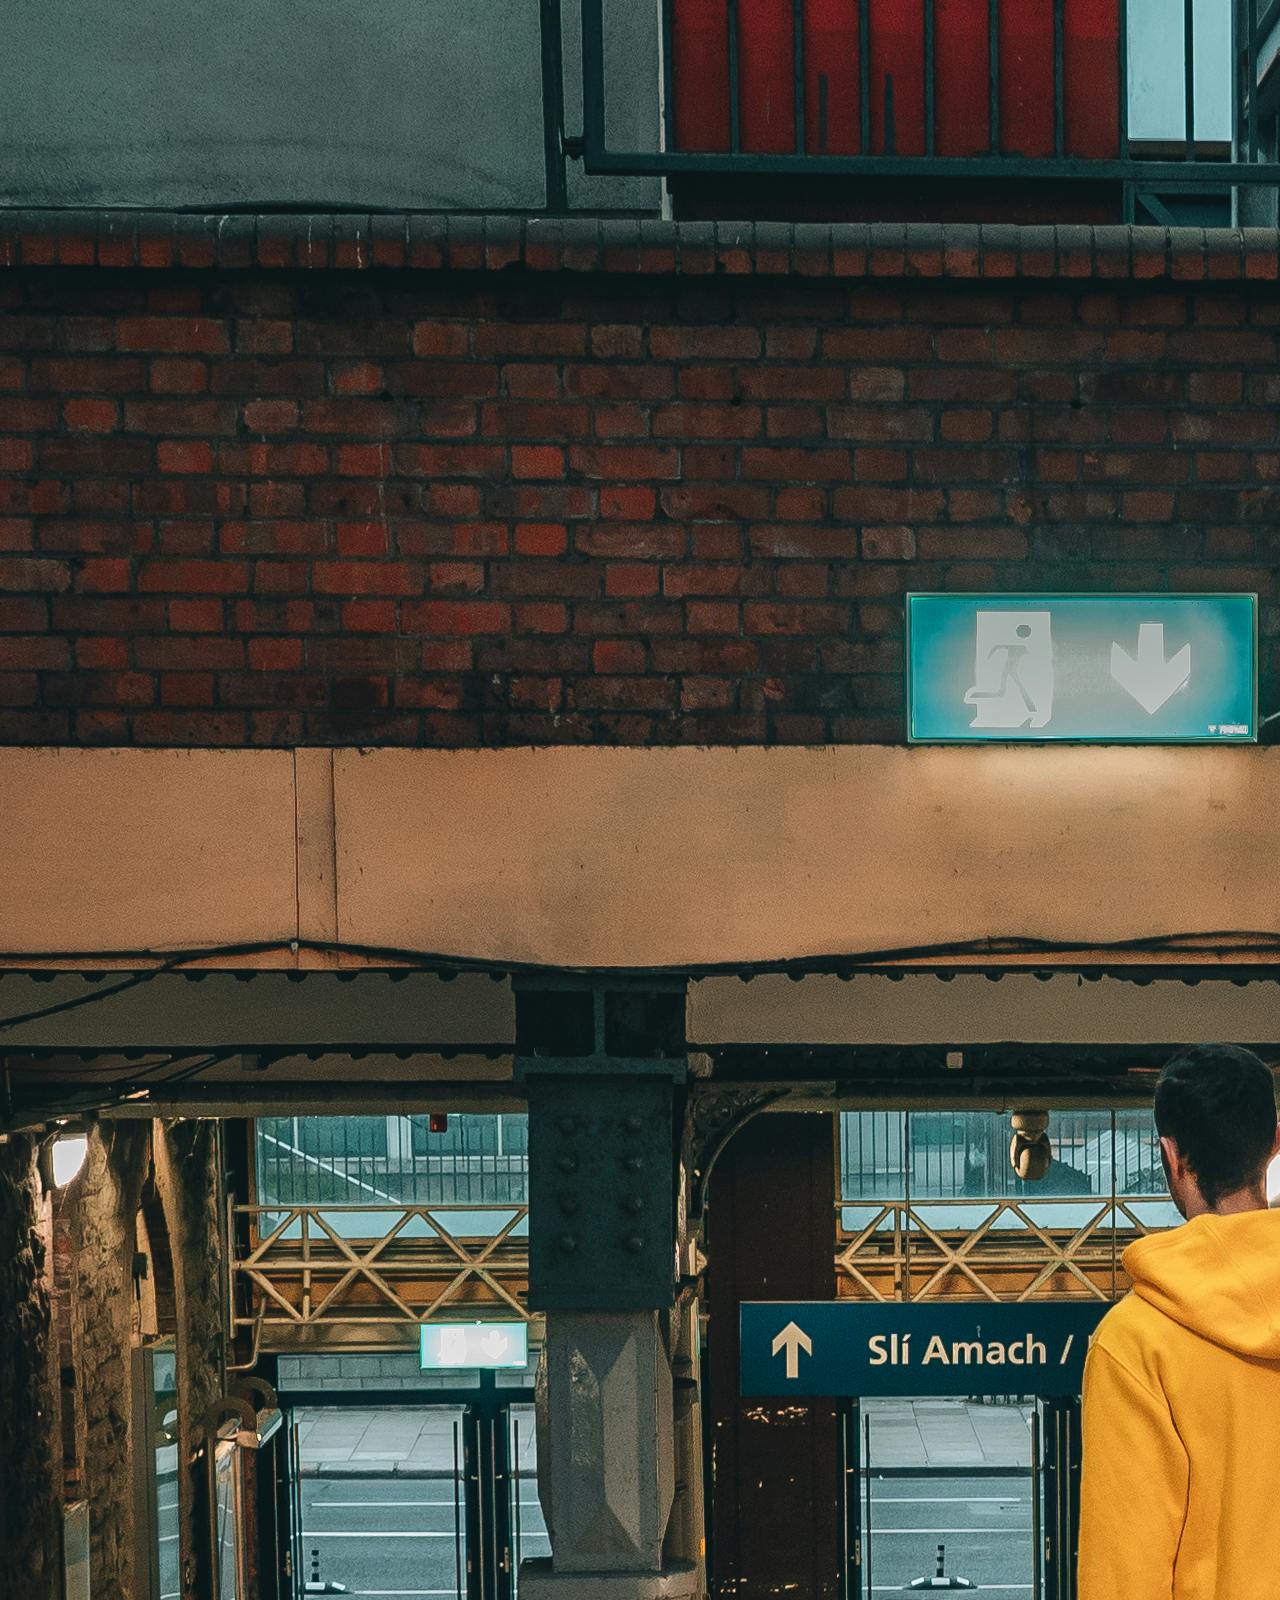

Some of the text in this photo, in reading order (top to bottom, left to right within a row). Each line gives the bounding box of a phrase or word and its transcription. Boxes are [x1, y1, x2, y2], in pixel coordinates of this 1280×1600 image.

[868, 1333, 911, 1365] Slí
[922, 1333, 1046, 1365] Amach
[1060, 1334, 1074, 1364] /
